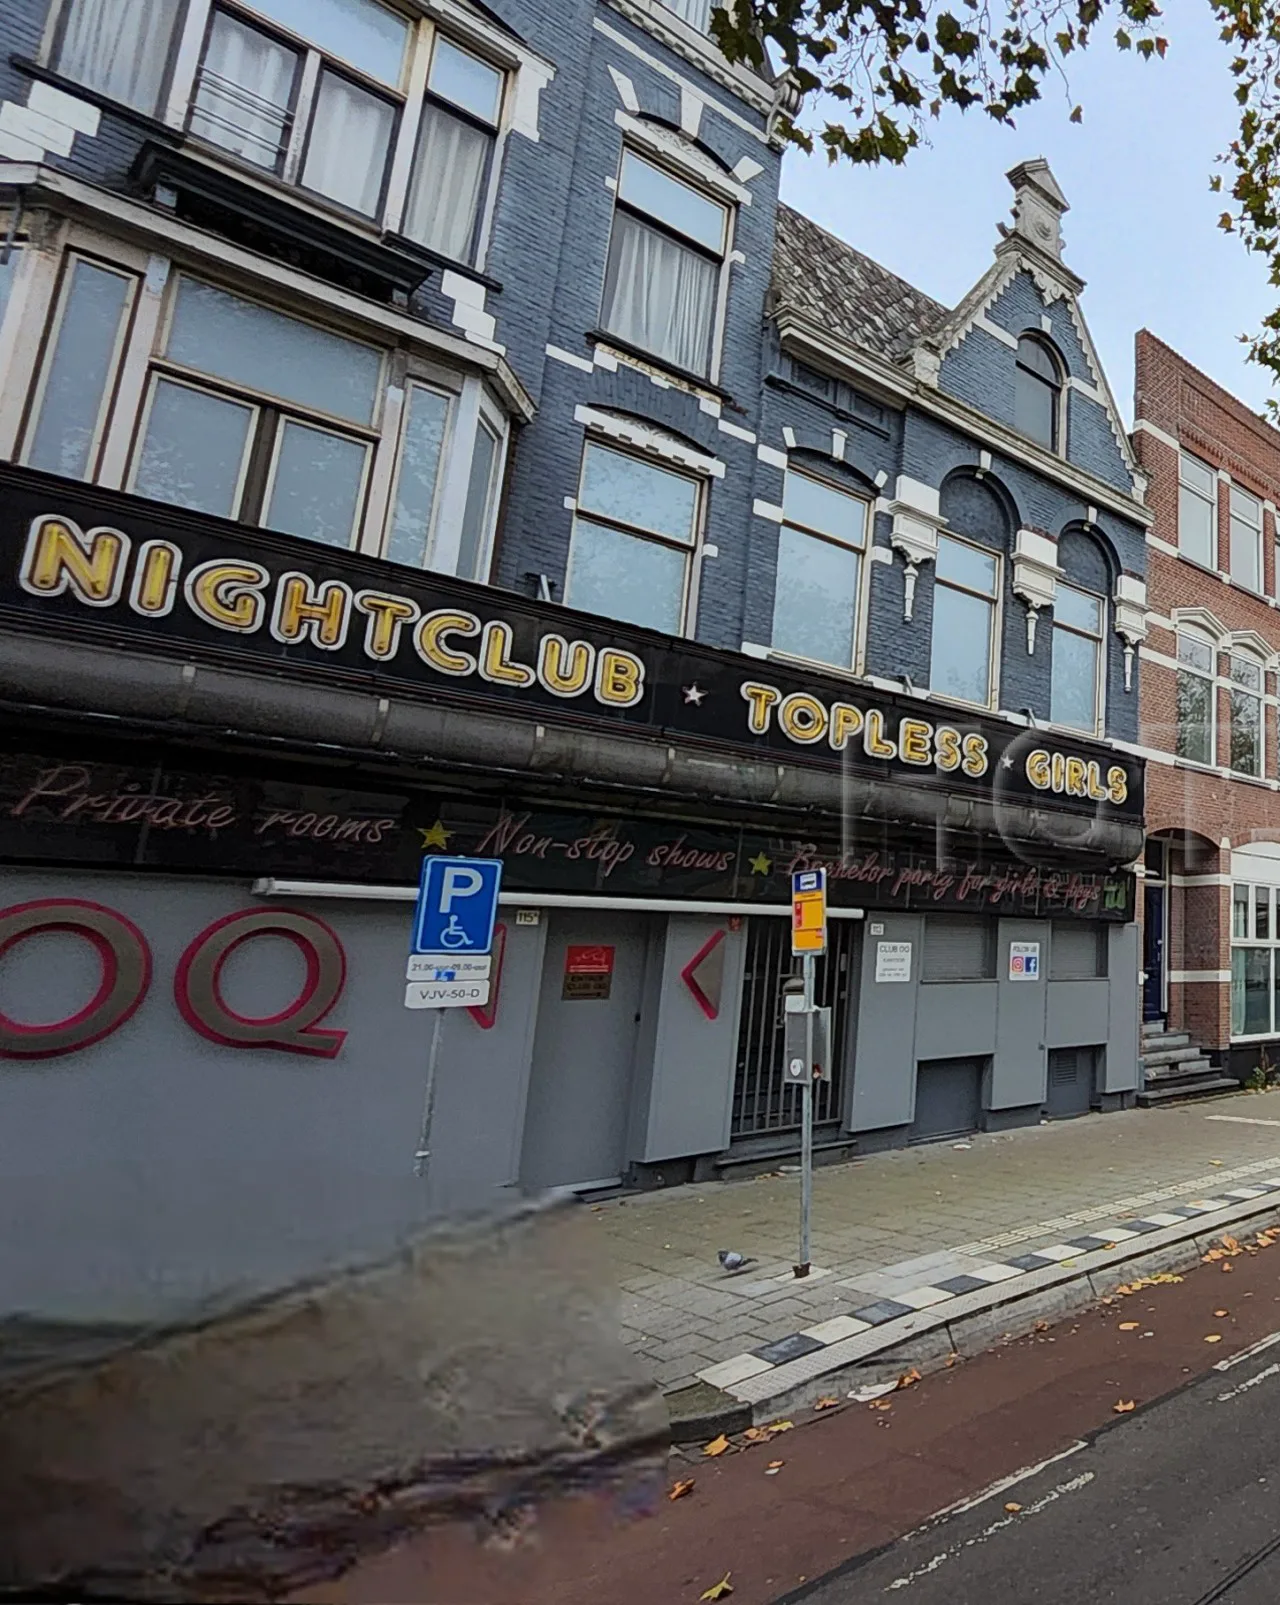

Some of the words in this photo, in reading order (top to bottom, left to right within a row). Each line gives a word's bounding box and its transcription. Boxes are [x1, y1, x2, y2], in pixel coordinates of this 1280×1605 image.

[19, 514, 646, 708] NIGHTCLUB
[740, 680, 989, 778] TOPLESS
[1025, 748, 1129, 804] GIRLS
[8, 764, 237, 829] Private
[257, 807, 396, 843] rooms
[474, 810, 637, 877] Non-stop
[647, 832, 737, 872] shows
[439, 866, 483, 914] P
